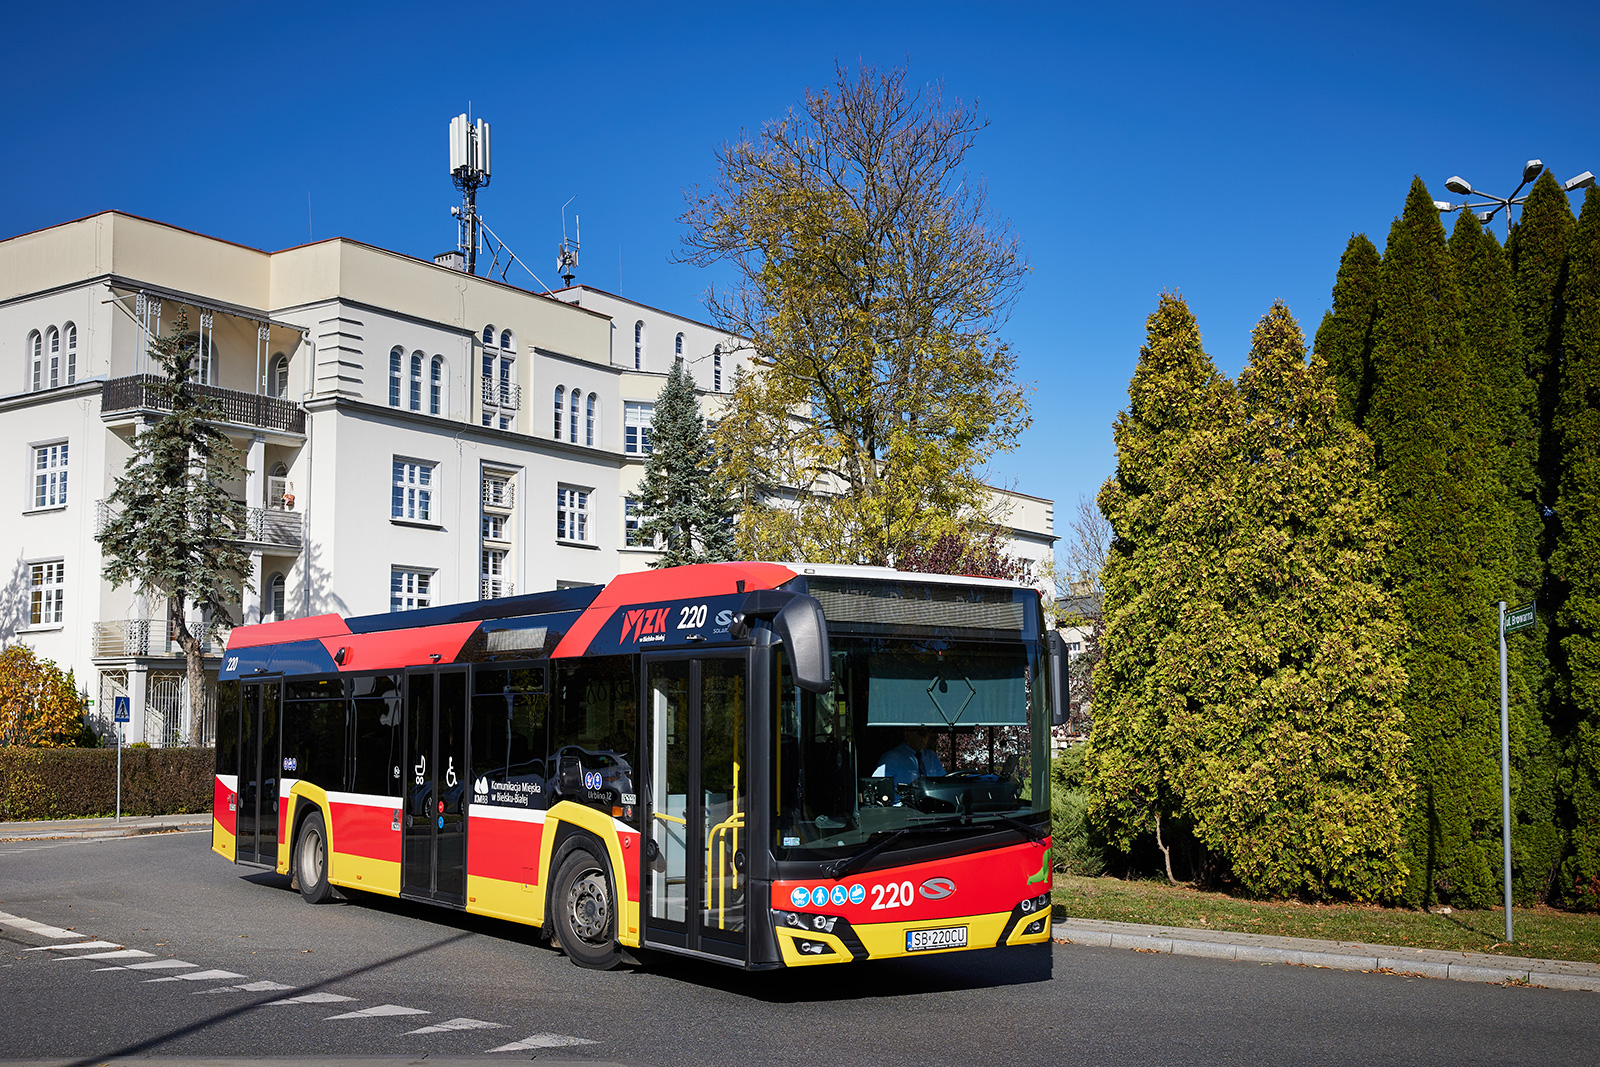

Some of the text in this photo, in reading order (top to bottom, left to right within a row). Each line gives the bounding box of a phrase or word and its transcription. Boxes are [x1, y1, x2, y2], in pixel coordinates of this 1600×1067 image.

[677, 604, 708, 630] 220
[225, 656, 239, 671] 220
[491, 780, 542, 795] Komunikacja Miejska
[587, 790, 606, 800] Urbino
[606, 791, 613, 801] 12
[491, 791, 529, 807] w Bielsku-Białej
[870, 881, 914, 911] 220
[914, 929, 965, 946] SB 220CU
